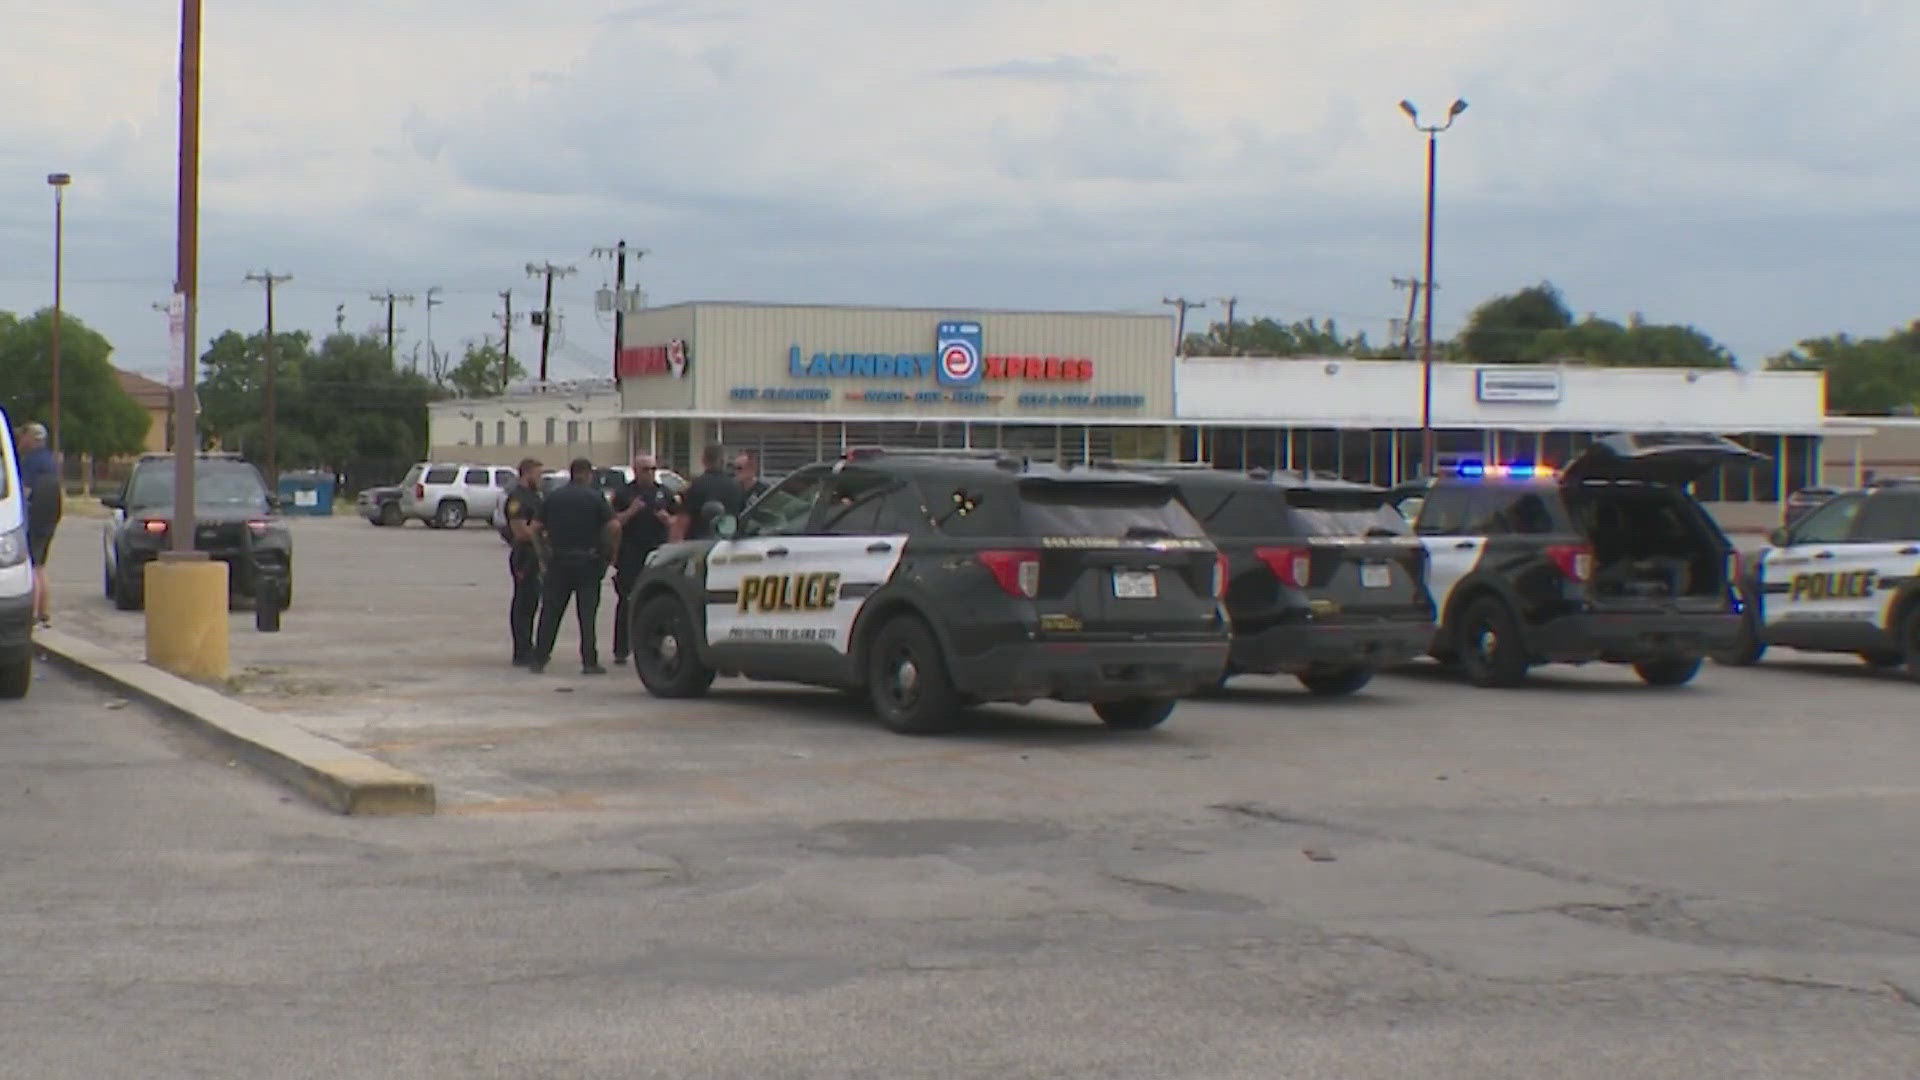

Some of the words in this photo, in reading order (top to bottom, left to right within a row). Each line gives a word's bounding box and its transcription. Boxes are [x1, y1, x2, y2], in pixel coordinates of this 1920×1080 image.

[788, 343, 933, 379] LAUNDRY
[738, 572, 841, 614] POLICE
[1790, 569, 1878, 602] POLICE
